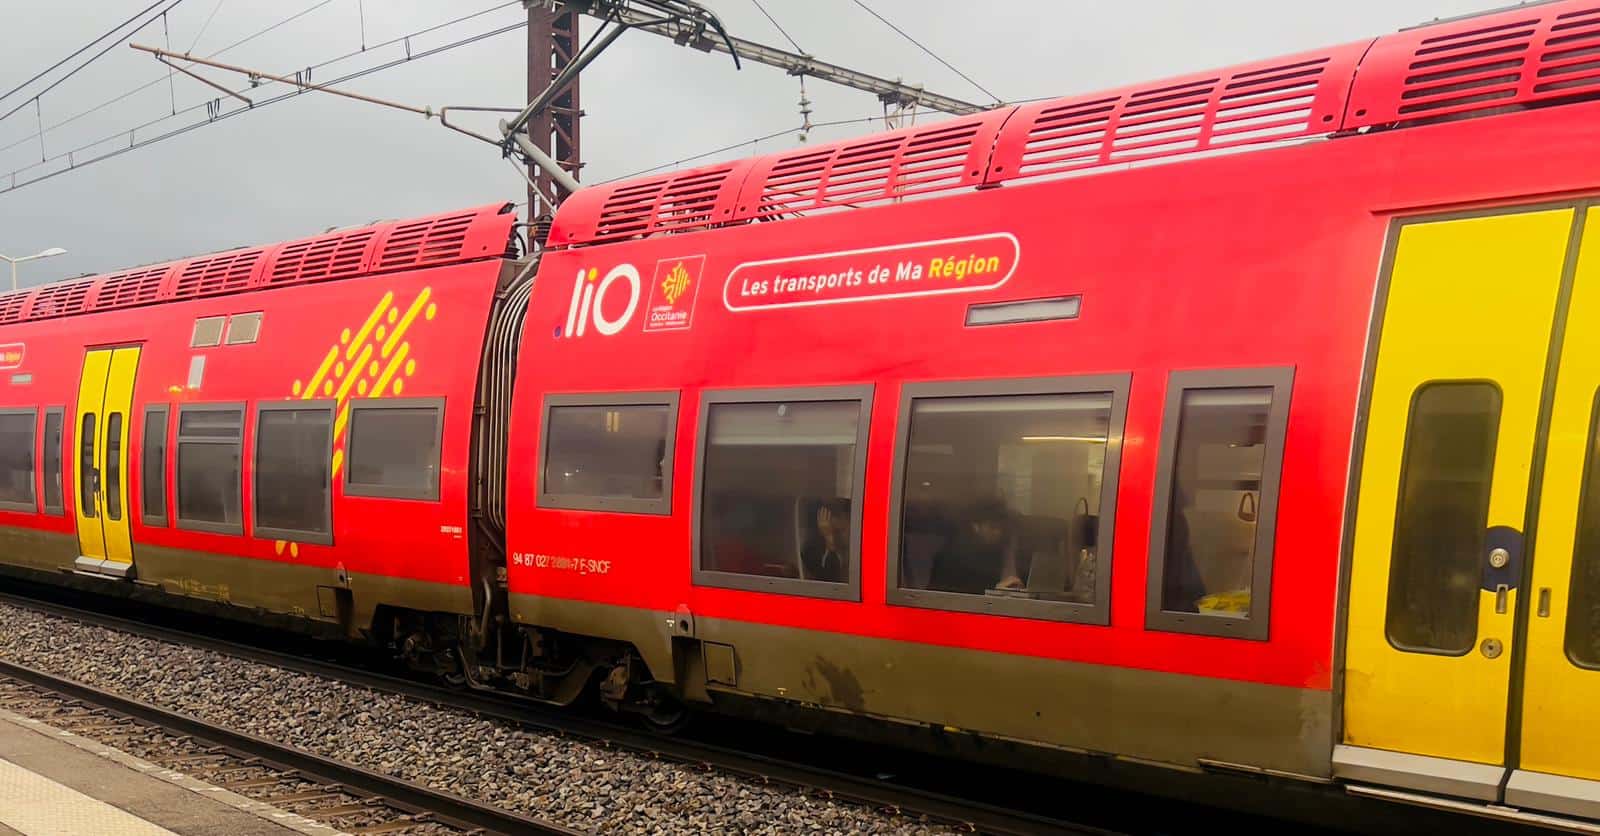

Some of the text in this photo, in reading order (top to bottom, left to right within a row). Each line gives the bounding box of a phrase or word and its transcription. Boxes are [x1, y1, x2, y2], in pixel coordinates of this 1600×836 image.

[741, 254, 1000, 297] Les transports de Ma Région
[512, 551, 523, 565] 94
[524, 553, 535, 566] 87
[580, 558, 612, 575] F-SNCF
